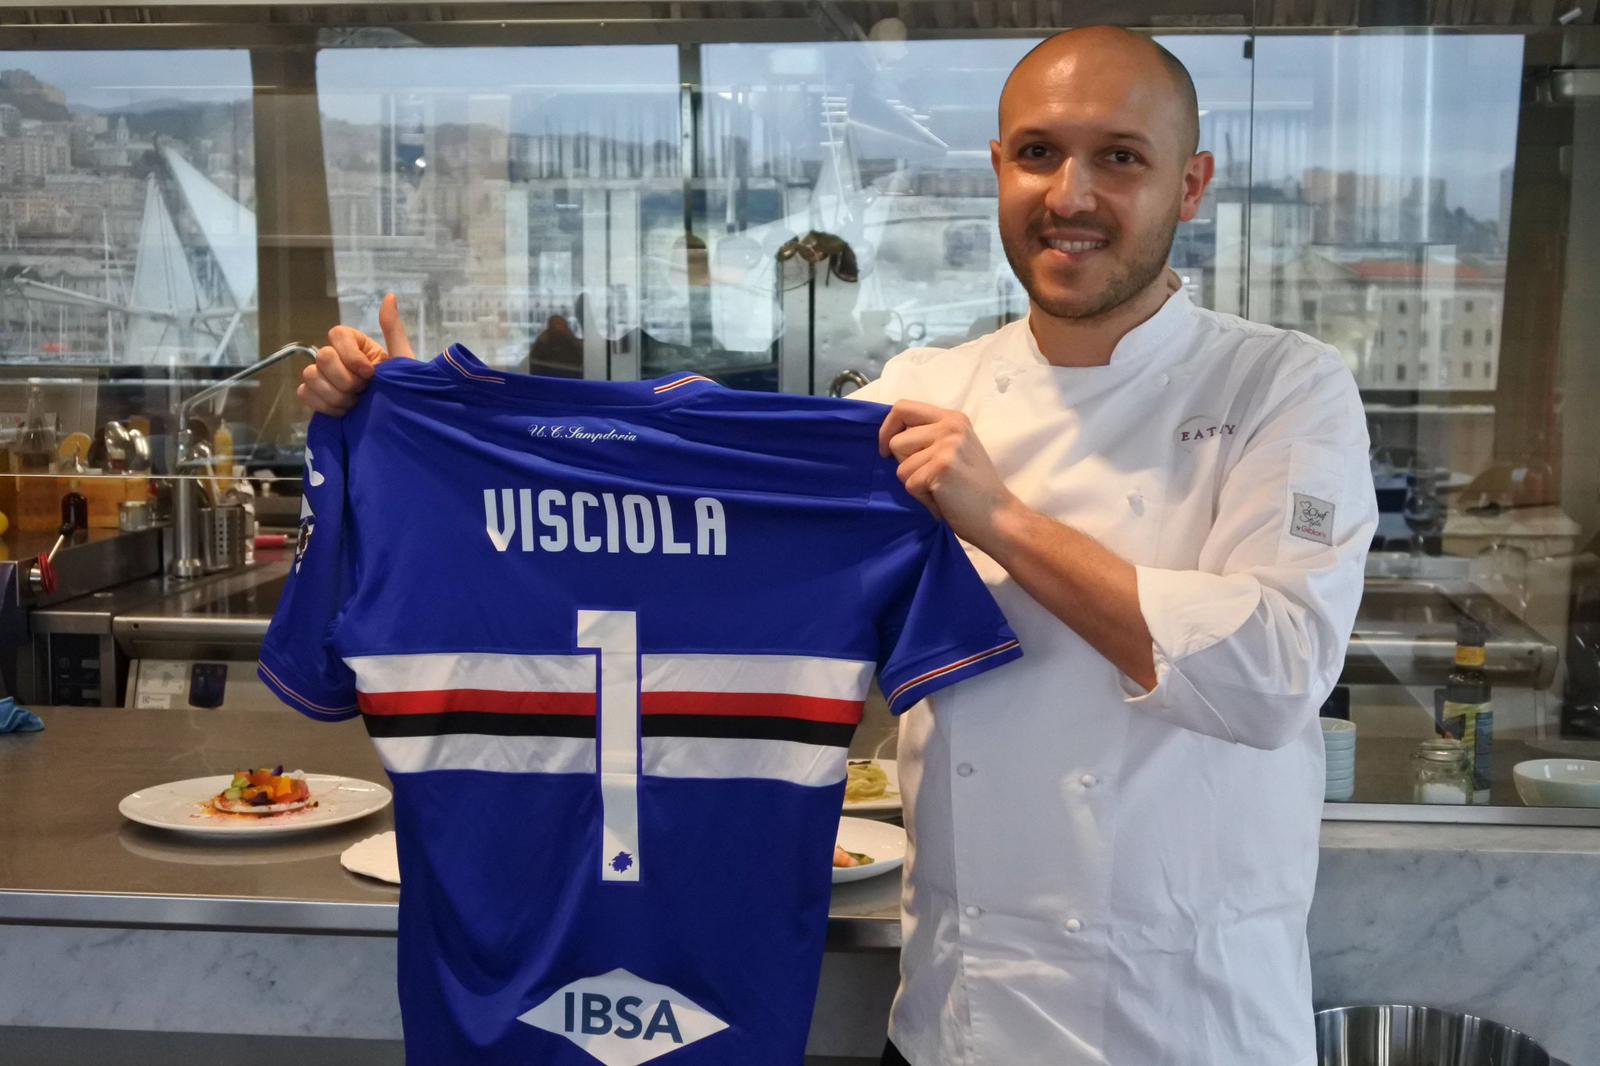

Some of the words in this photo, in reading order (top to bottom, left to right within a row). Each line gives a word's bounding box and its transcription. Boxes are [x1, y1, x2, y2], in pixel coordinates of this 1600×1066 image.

[564, 423, 638, 442] Sampdoria
[483, 488, 727, 556] VISCIOLA
[577, 609, 640, 882] 1
[564, 991, 684, 1044] IBSA
